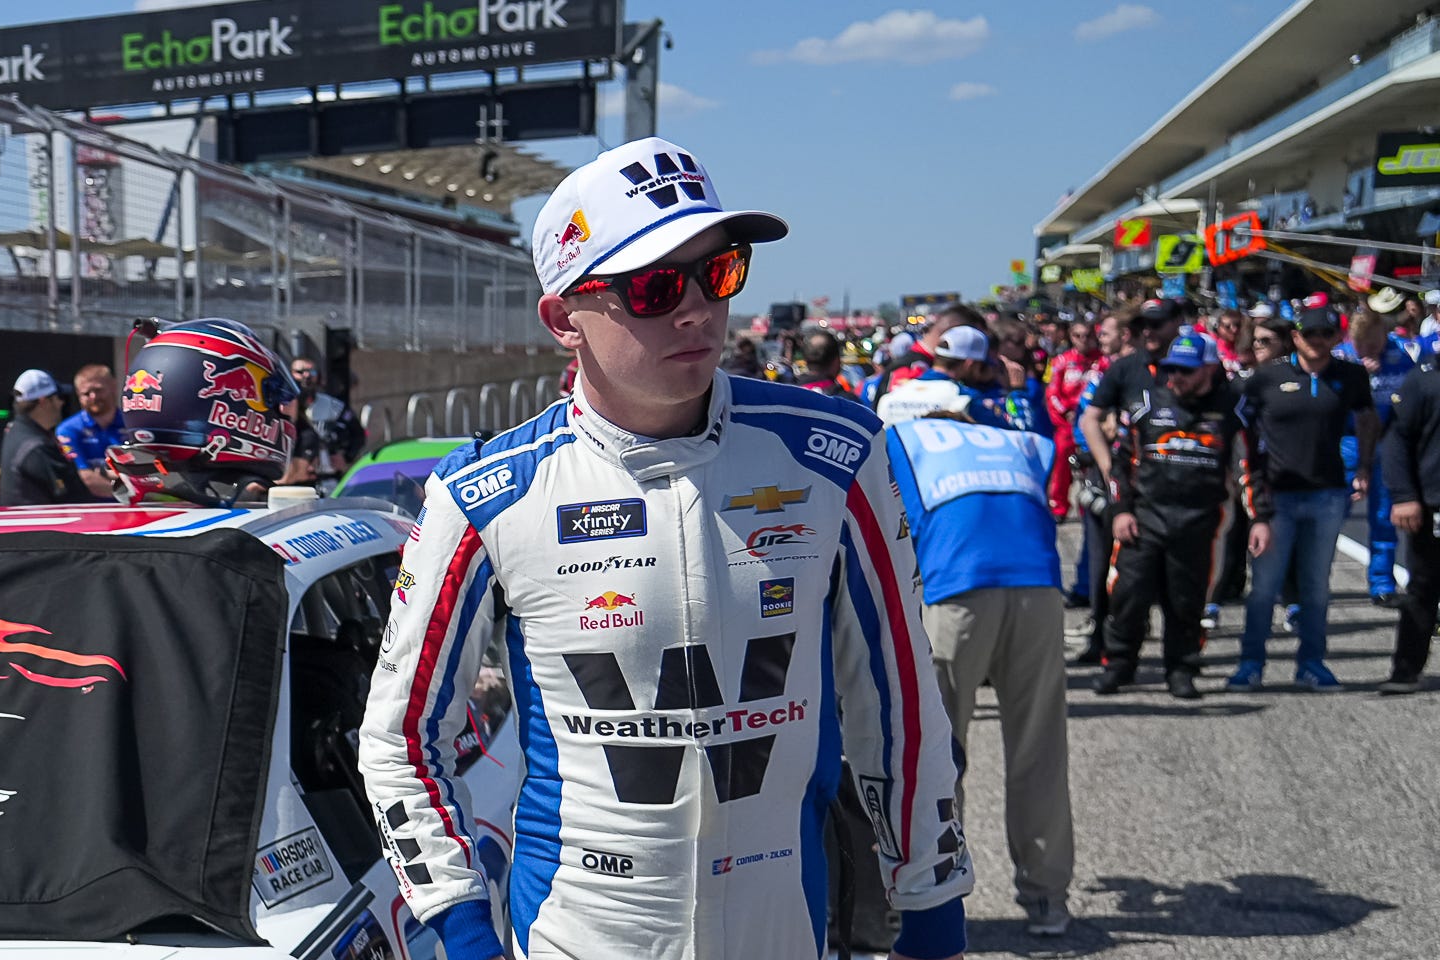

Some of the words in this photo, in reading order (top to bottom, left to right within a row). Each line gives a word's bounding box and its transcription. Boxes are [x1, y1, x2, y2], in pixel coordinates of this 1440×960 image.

[122, 17, 293, 71] EchoPark
[411, 41, 536, 66] AUTOMOTIVE
[152, 68, 265, 91] AUTOMOTIVE
[625, 172, 705, 199] WeatherTech
[209, 401, 252, 432] Red
[248, 410, 280, 446] Bull
[808, 434, 860, 466] OMP
[461, 468, 512, 504] OMP
[591, 503, 621, 514] NASCAR
[572, 513, 632, 534] xfinity
[589, 527, 615, 537] SERIES
[728, 554, 820, 567] MOTORSPORTS
[763, 601, 792, 611] ROOKIE
[580, 613, 610, 630] Red
[613, 610, 645, 628] Bull
[272, 837, 317, 869] NASCAR
[582, 853, 634, 874] OMP
[270, 867, 304, 893] RACE
[302, 858, 326, 878] CAR
